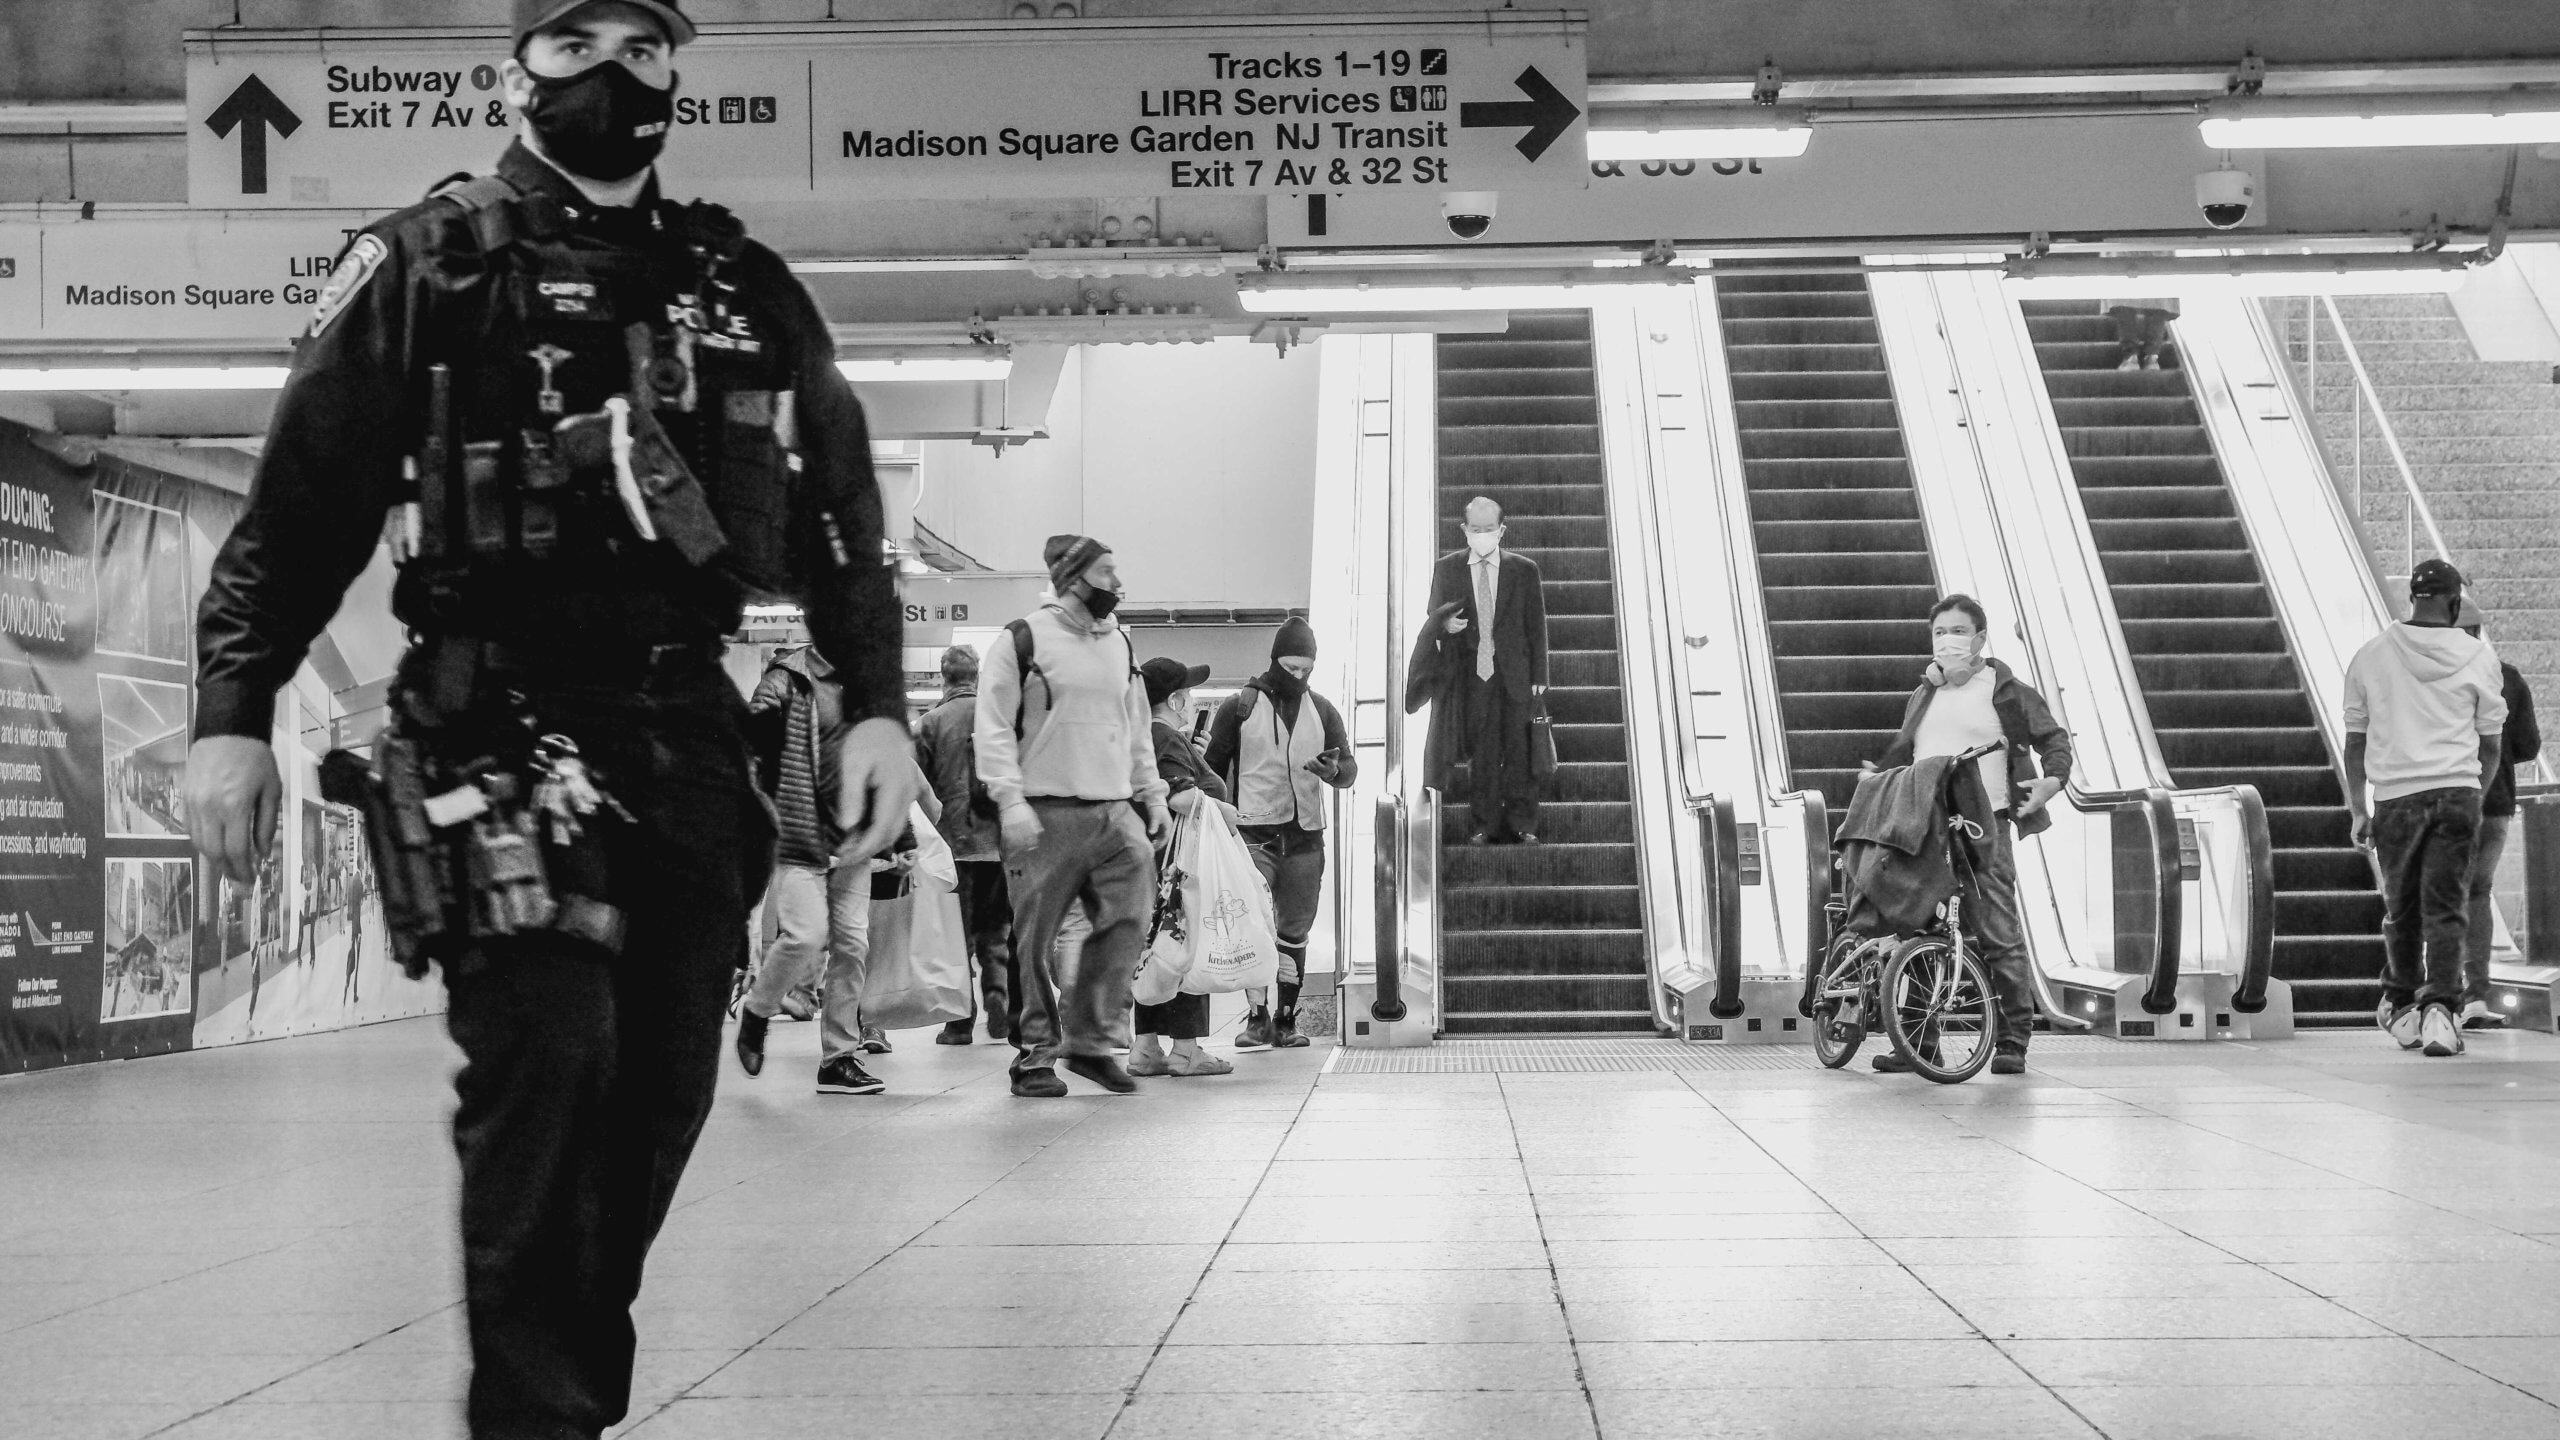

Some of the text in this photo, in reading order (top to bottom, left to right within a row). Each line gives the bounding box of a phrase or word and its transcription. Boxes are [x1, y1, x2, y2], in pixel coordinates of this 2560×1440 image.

[1208, 52, 1322, 80] Tracks
[327, 65, 462, 98] Subway
[328, 97, 711, 129] Exit 7 Av & St
[1141, 87, 1380, 117] LIRR Services
[842, 124, 1254, 160] Madison Square Garden
[1276, 120, 1448, 150] NJ Transit
[1171, 155, 1448, 188] Exit 7 Av & 32 St
[290, 256, 335, 278] LIR
[66, 285, 176, 306] Madison
[184, 284, 275, 310] Square
[12, 540, 38, 582] END
[40, 546, 89, 593] GATEWAY
[905, 604, 927, 622] St
[28, 692, 62, 713] commute
[1, 721, 14, 745] and
[20, 723, 39, 747] wider
[40, 726, 68, 749] corridor
[6, 794, 18, 817] and
[19, 795, 28, 817] air
[28, 795, 64, 819] circulation
[35, 831, 48, 854] and
[49, 831, 87, 859] wayfinding
